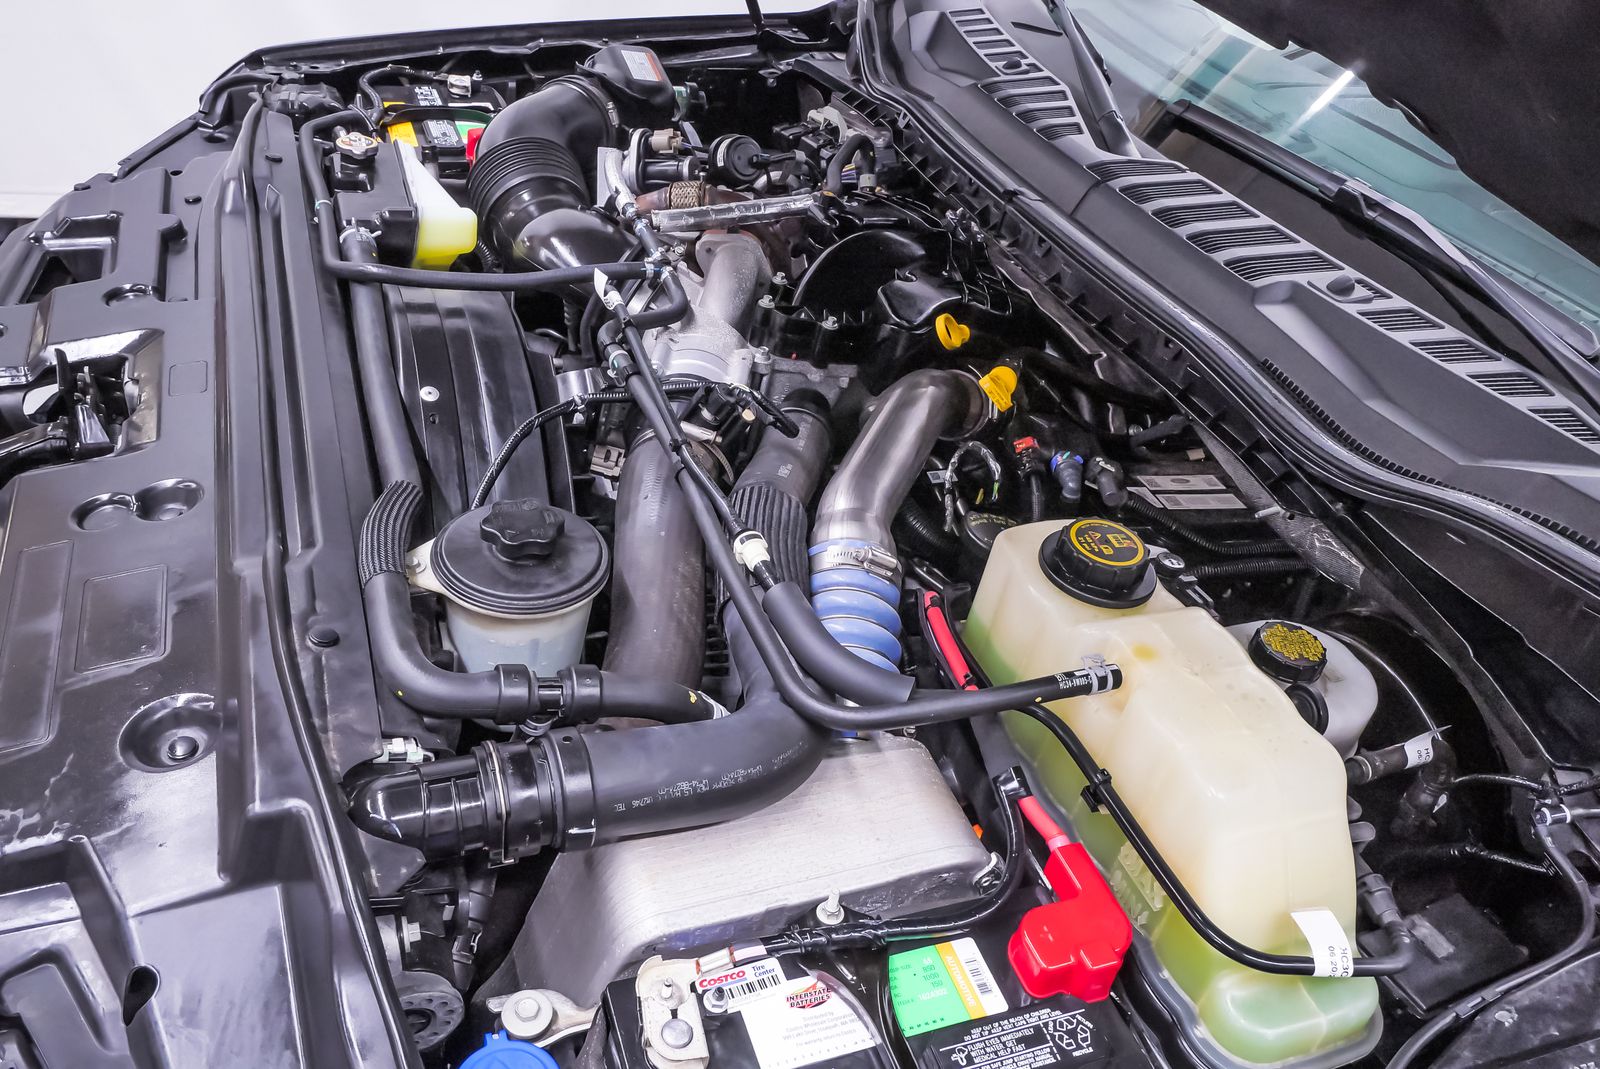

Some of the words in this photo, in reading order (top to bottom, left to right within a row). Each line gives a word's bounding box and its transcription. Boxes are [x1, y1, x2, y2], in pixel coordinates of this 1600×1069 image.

[752, 964, 766, 972] Tire
[754, 968, 775, 978] Center
[699, 970, 746, 988] COSTCO
[946, 955, 976, 1007] AUTOMOTIVE
[786, 987, 831, 1002] INTERSTATE
[790, 994, 830, 1008] BATTERIES
[1075, 1014, 1094, 1029] RETURN
[967, 1040, 985, 1052] FLUSH
[986, 1037, 1000, 1046] EYES
[1000, 1028, 1034, 1042] IMMEDIATELY
[970, 1049, 985, 1058] WITH
[1006, 1040, 1017, 1048] GET
[974, 1053, 998, 1063] MEDICAL
[997, 1048, 1011, 1056] HELP
[1012, 1044, 1026, 1052] FAST
[1072, 1046, 1094, 1057] RECYCLE
